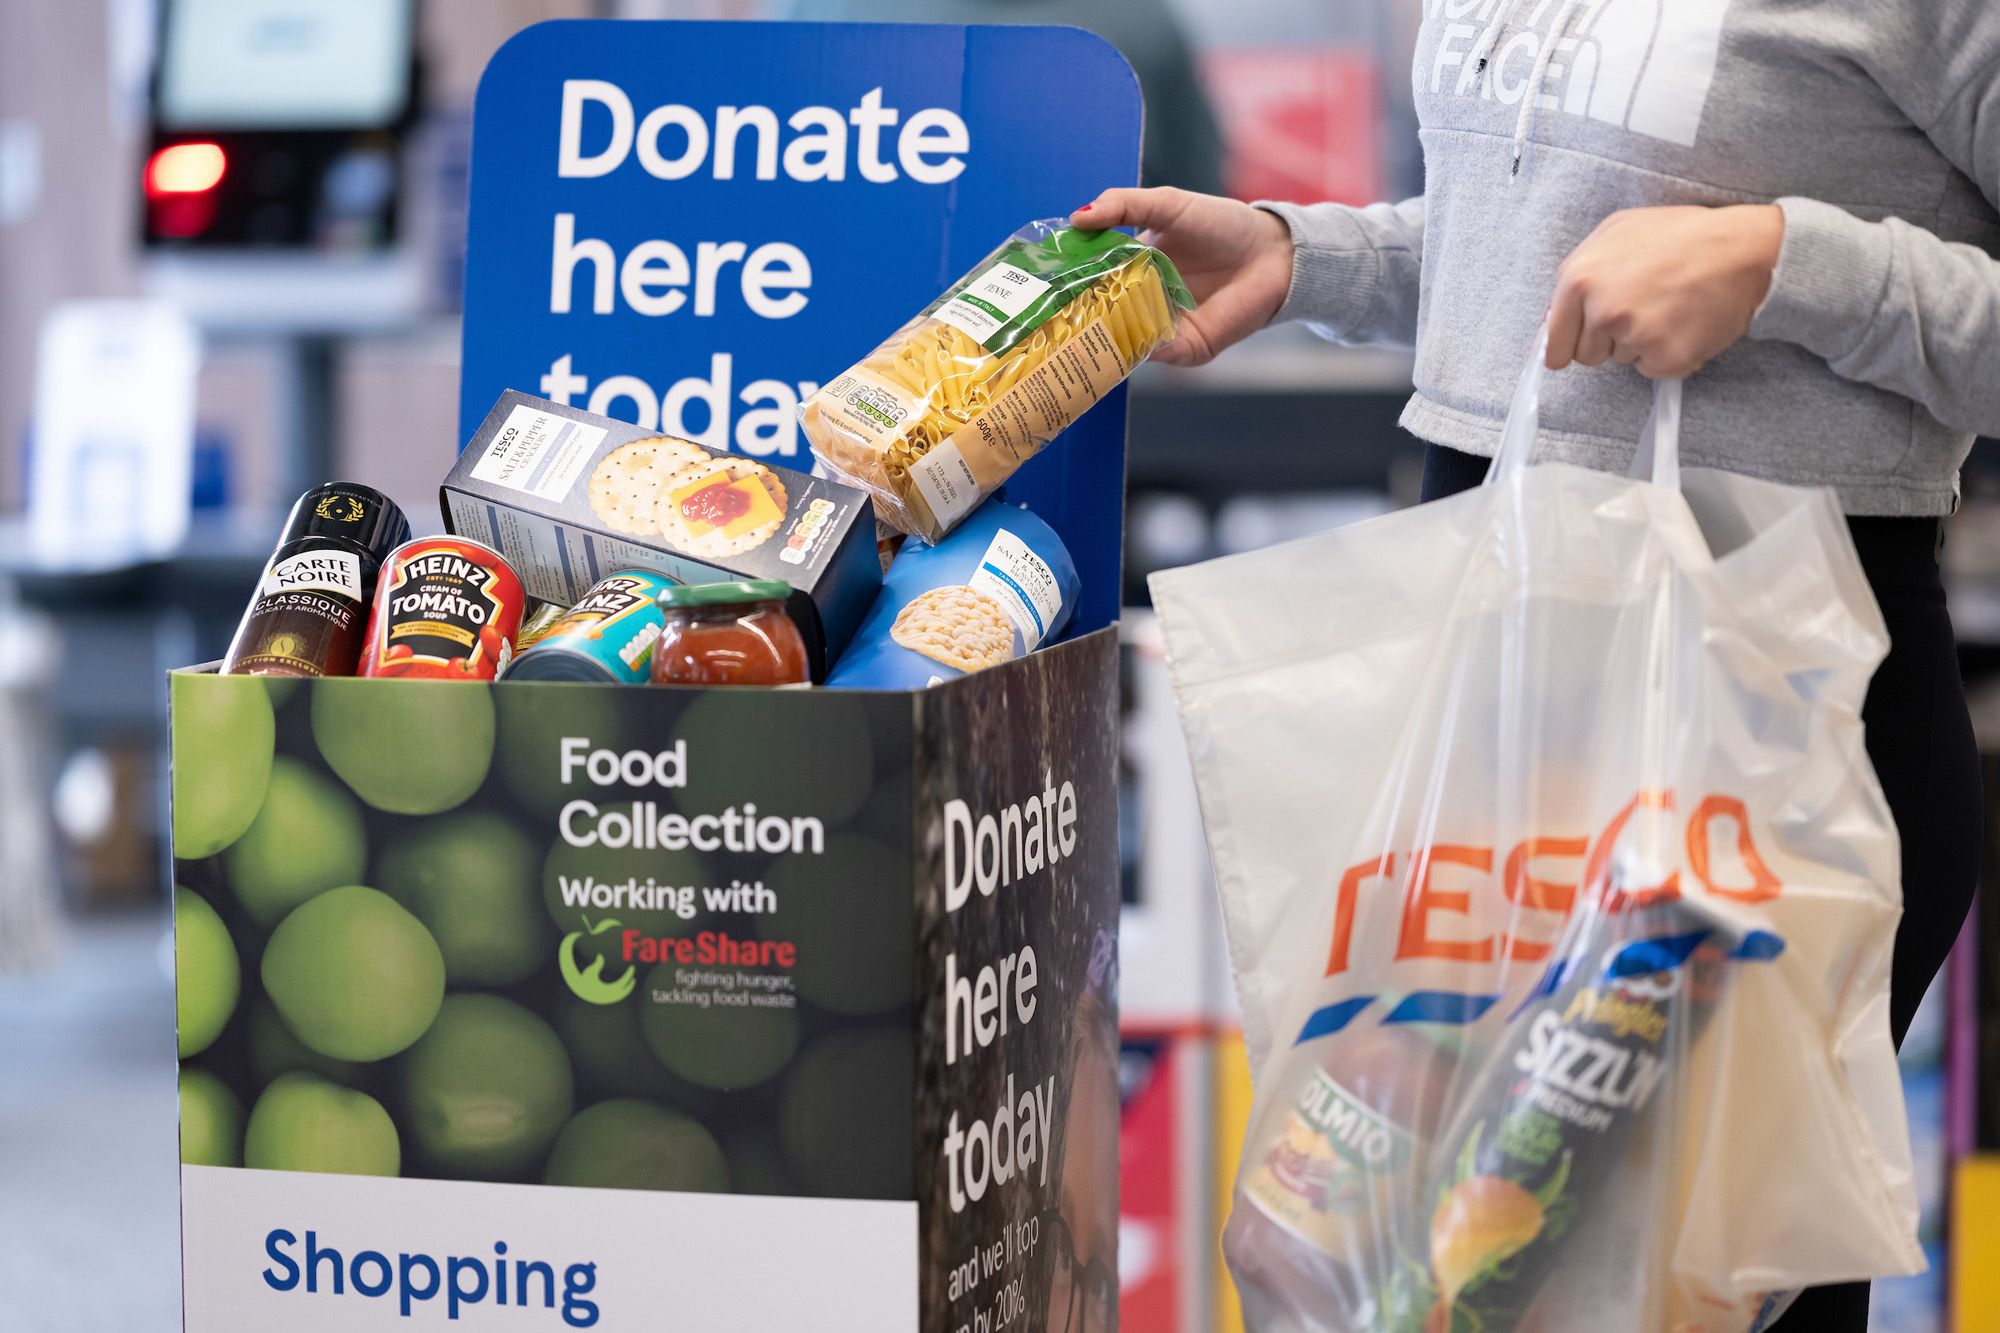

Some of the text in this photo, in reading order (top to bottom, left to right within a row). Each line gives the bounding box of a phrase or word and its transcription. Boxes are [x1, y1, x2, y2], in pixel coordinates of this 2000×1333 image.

[557, 79, 970, 184] Donate
[549, 213, 812, 319] here
[1006, 270, 1029, 283] TESCO
[984, 283, 1013, 299] PENNE
[540, 352, 822, 460] toda
[490, 427, 517, 457] TESCO
[499, 454, 520, 481] SALT
[519, 417, 548, 451] PEPPER
[976, 418, 992, 441] 500g
[277, 559, 351, 577] CARTE
[280, 572, 352, 588] NOIRE
[409, 556, 485, 587] HEINZ
[997, 545, 1019, 565] SALT
[1029, 570, 1054, 615] VINEGAR
[1022, 549, 1052, 586] TESCO
[255, 594, 351, 625] CLASSIQUE
[392, 592, 485, 625] TOMATO
[420, 585, 463, 596] CREAM OF
[999, 571, 1017, 589] TANGY
[1022, 592, 1041, 623] CRUNCHY
[295, 605, 348, 631] AROMATIQUE
[423, 611, 448, 620] SOUP
[560, 737, 688, 787] Food
[559, 800, 824, 854] Collection
[944, 766, 1078, 912] Donate
[558, 876, 777, 919] Working with
[1324, 788, 1784, 979] TESCO
[621, 929, 797, 968] FareShare
[652, 989, 797, 1009] tackling food waste
[675, 968, 796, 993] fighting hunger,
[945, 945, 1038, 1065] here
[944, 1072, 1055, 1213] today
[1300, 1079, 1392, 1164] OLMIO
[262, 1229, 600, 1328] Shopping
[948, 1215, 1039, 1302] and we'll top
[995, 1273, 1025, 1332] 20%
